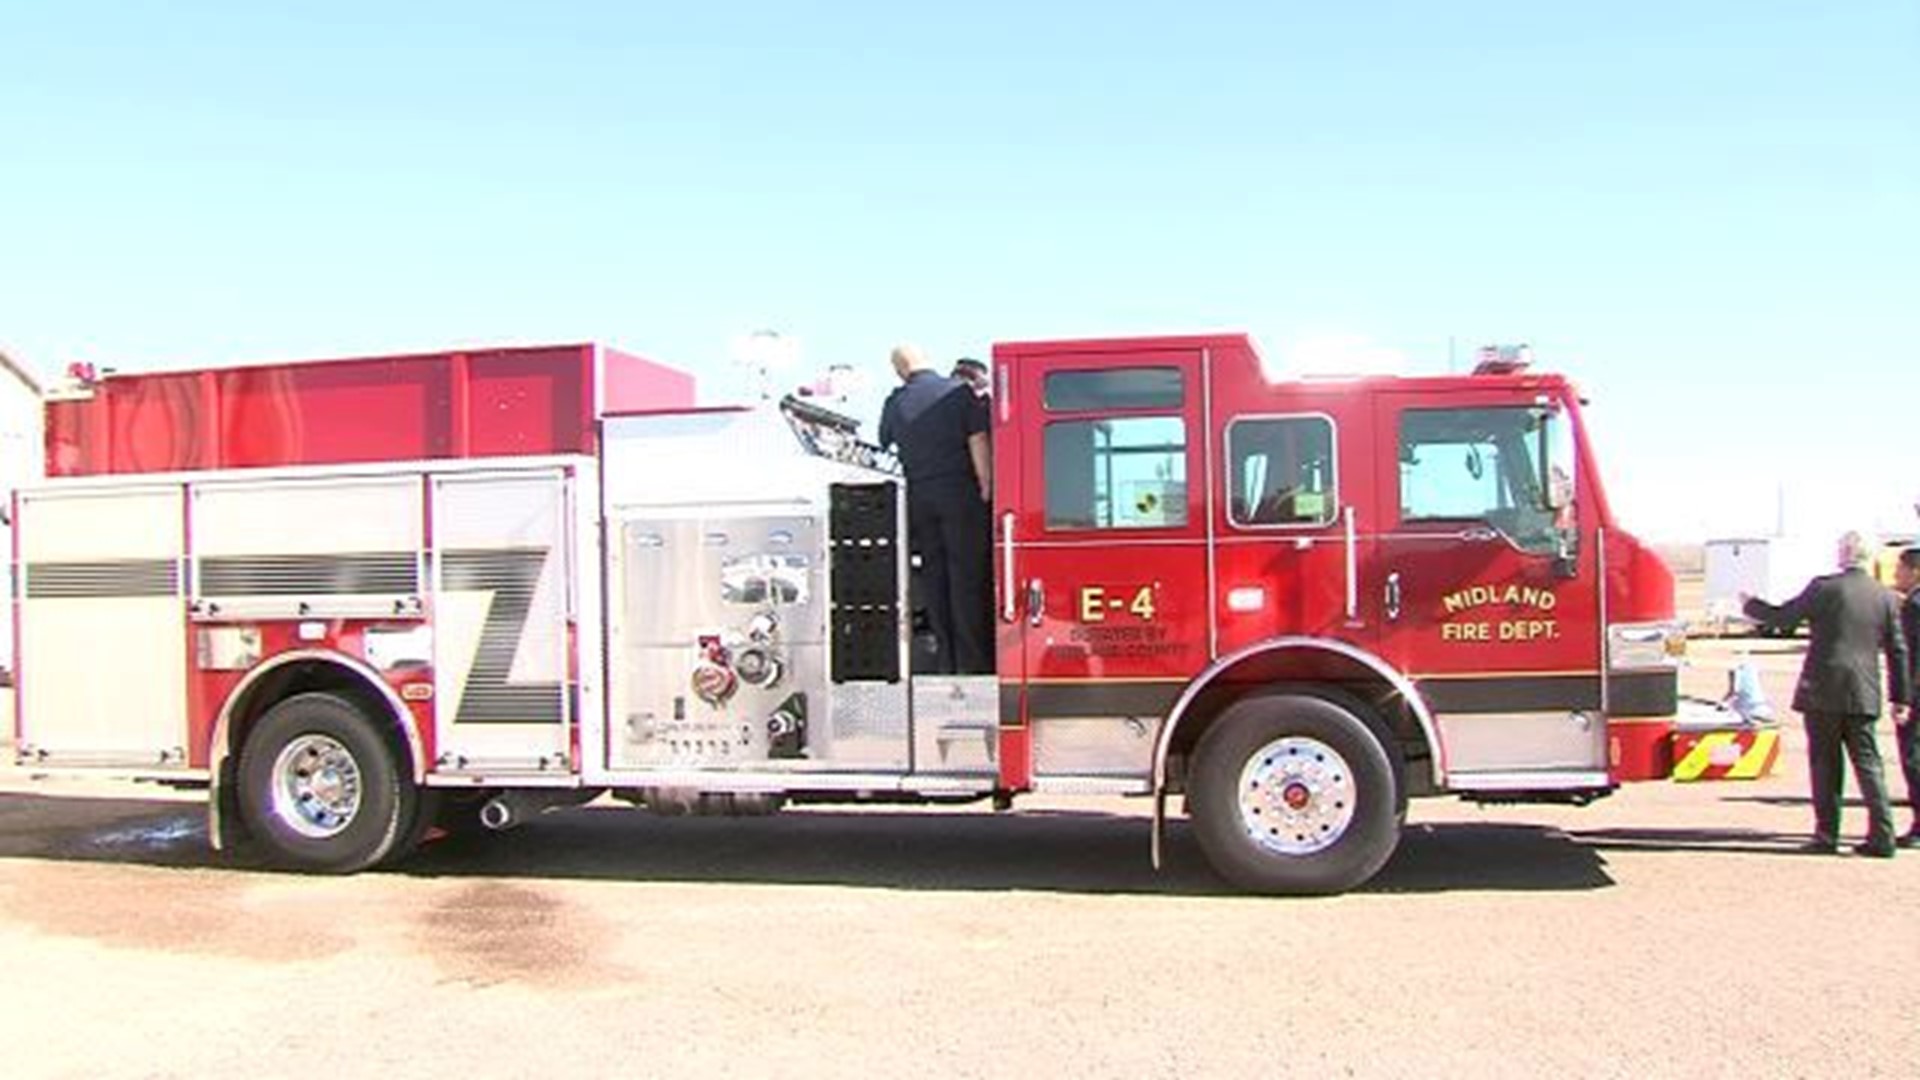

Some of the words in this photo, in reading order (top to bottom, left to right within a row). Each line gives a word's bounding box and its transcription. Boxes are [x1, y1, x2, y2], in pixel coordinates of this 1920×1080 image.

[1081, 586, 1155, 621] E-4
[1442, 585, 1556, 613] MIDLAND
[1442, 622, 1491, 640] FIRE
[1499, 620, 1561, 640] DEPT.
